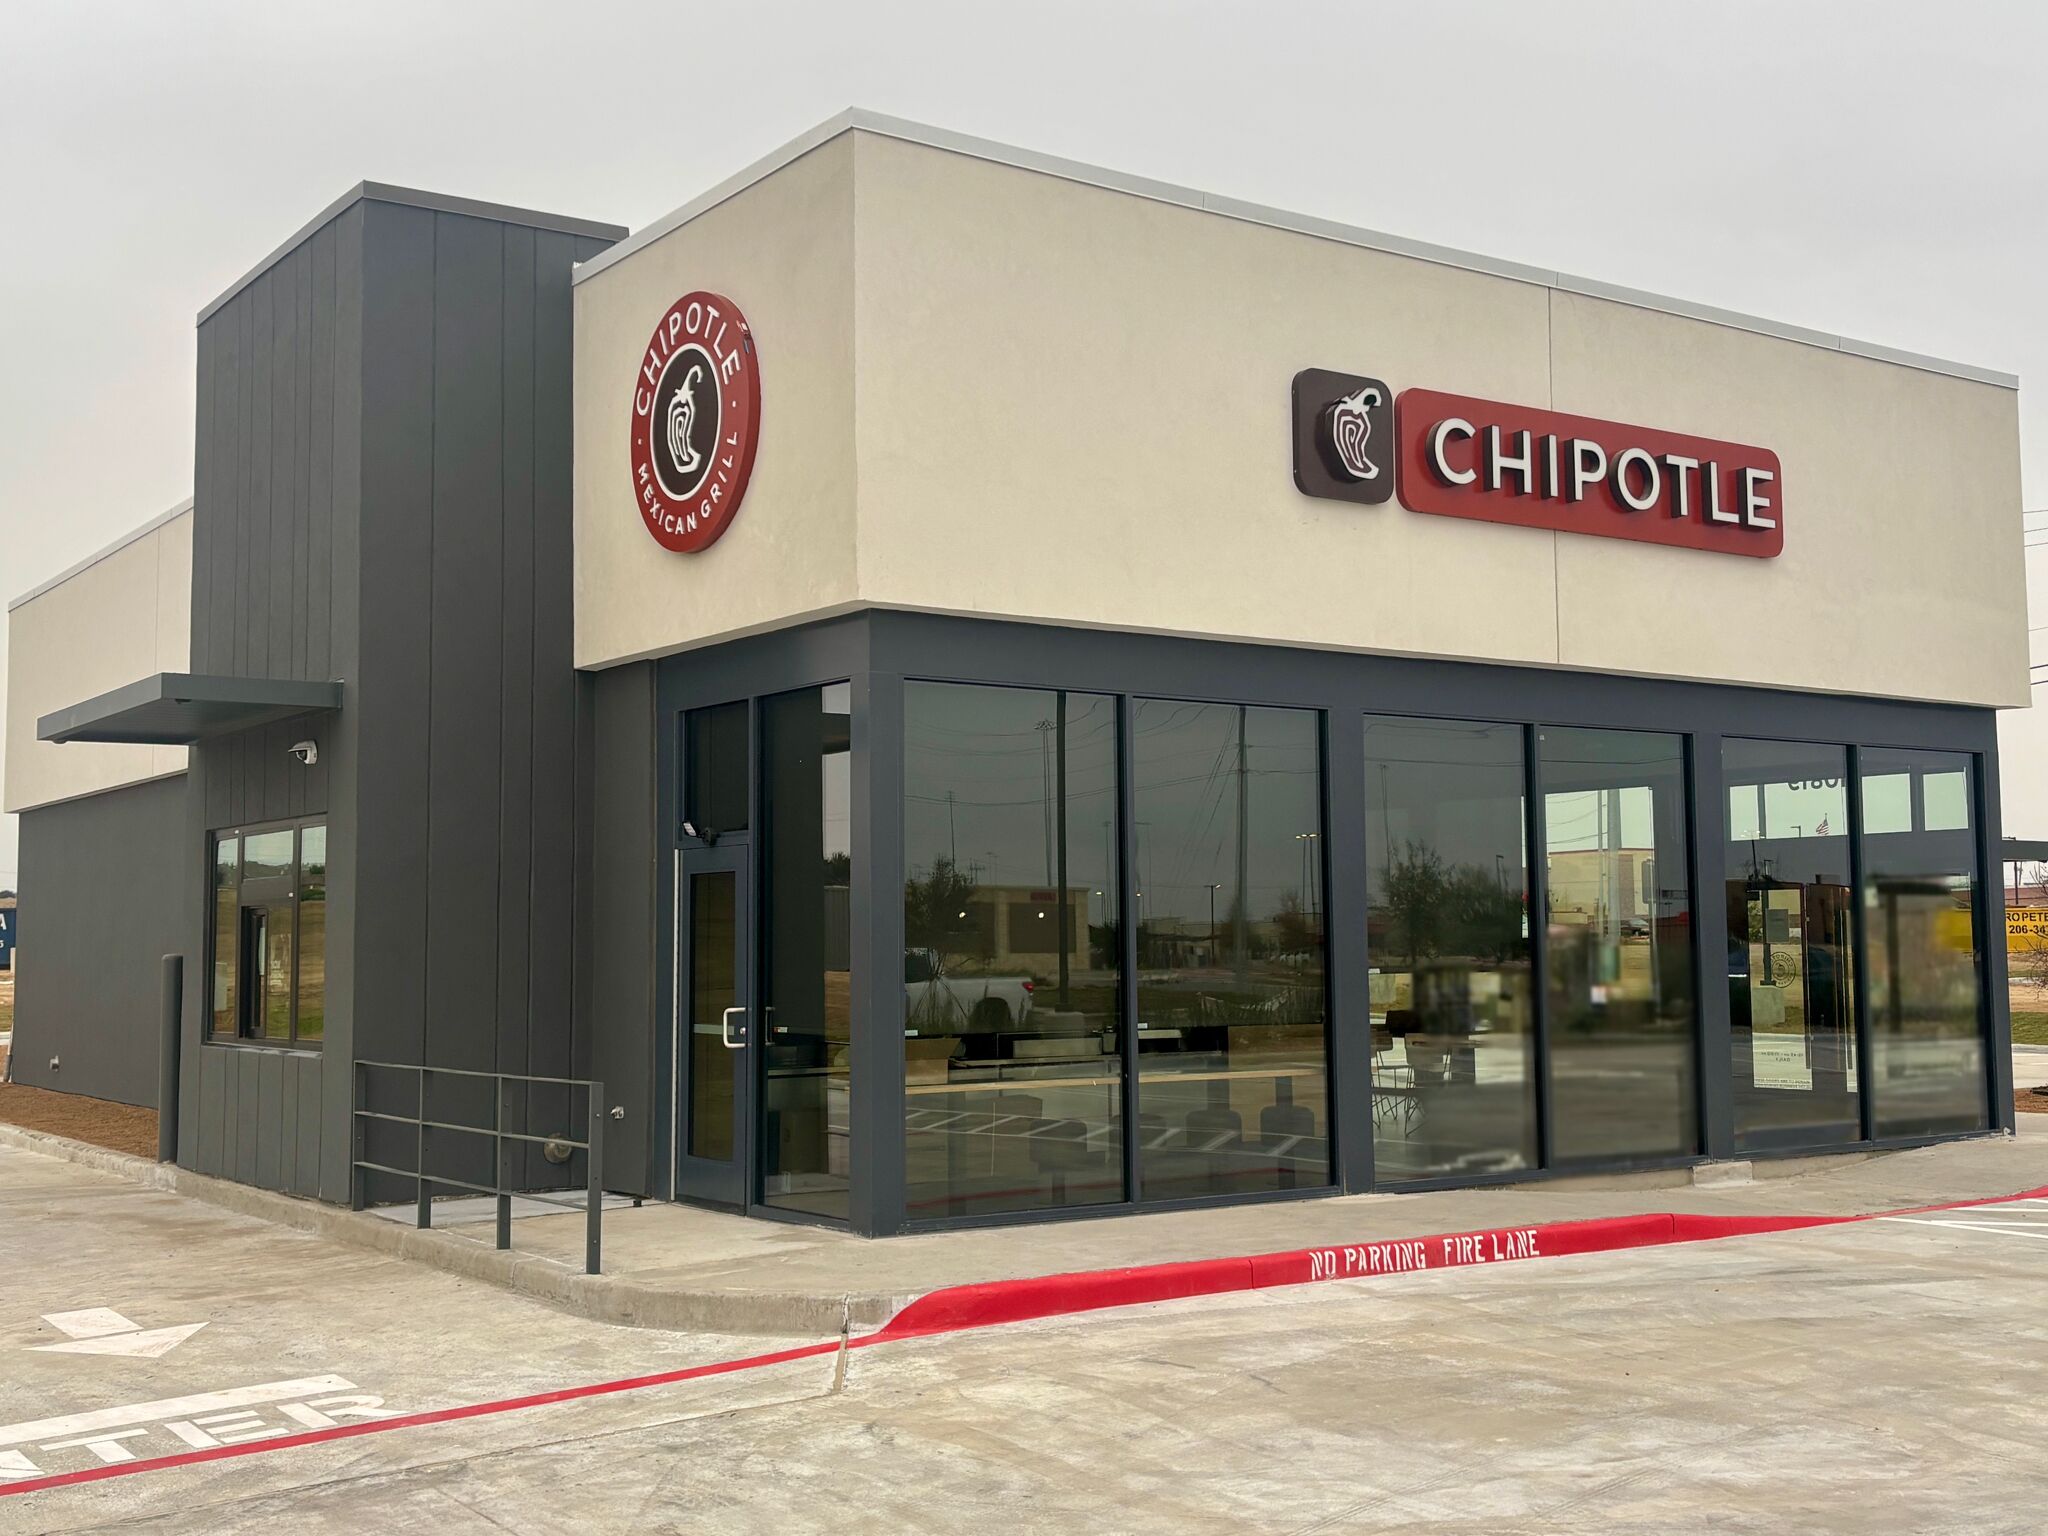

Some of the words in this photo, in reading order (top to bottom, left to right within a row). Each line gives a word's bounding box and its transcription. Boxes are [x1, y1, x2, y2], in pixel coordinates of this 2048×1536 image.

[636, 302, 742, 416] CHIPOTLE
[637, 462, 698, 535] MEXICAN
[700, 431, 738, 518] GRILL
[1430, 417, 1777, 530] CHIPOTLE
[1308, 1249, 1337, 1281] NO
[1343, 1241, 1427, 1273] PARKING
[1442, 1234, 1487, 1265] FIRE
[1491, 1229, 1541, 1260] LANE
